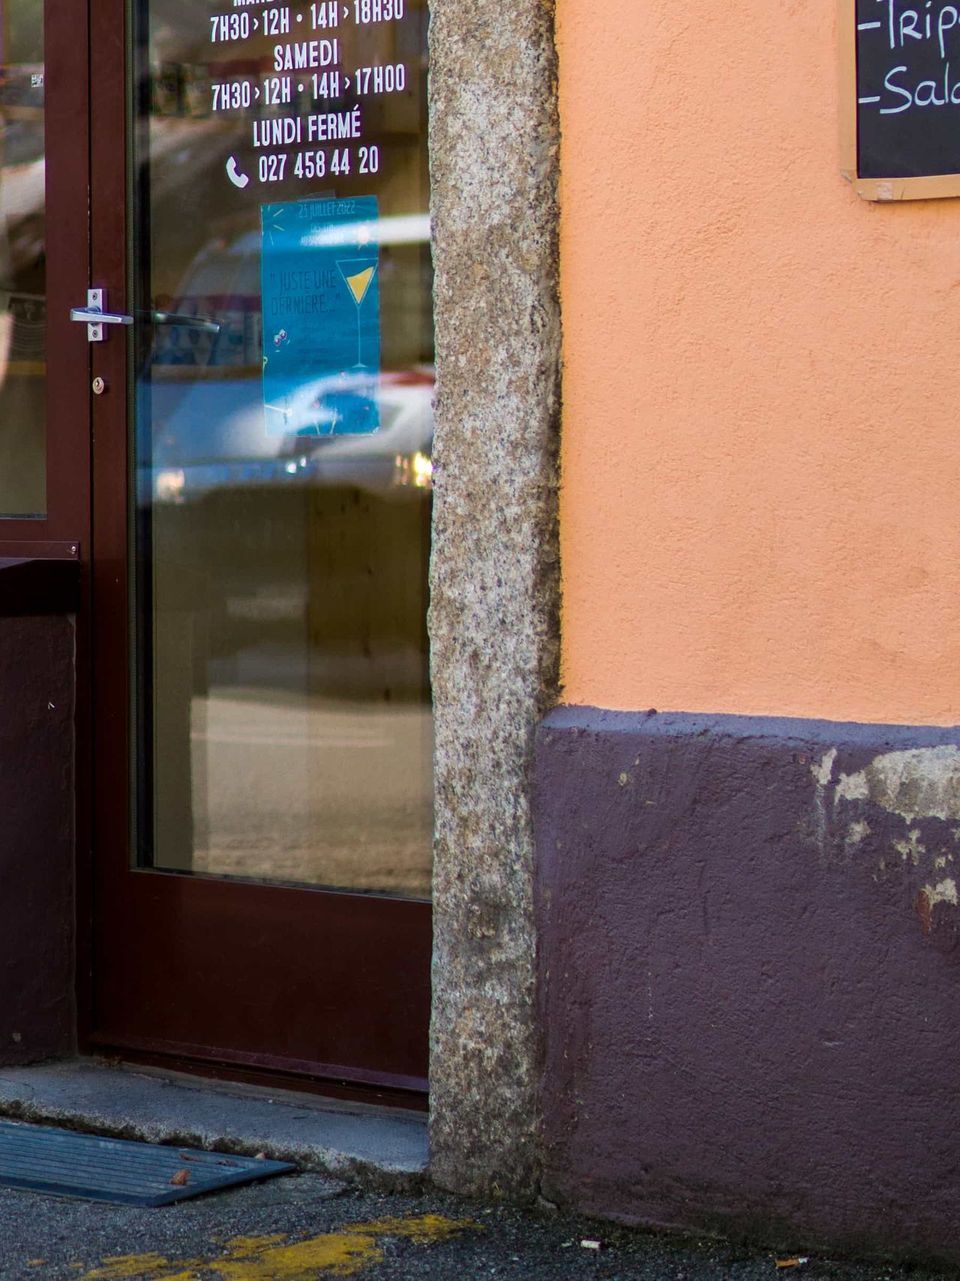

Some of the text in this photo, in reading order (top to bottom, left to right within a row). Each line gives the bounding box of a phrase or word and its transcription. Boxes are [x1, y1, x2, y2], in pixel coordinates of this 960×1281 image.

[273, 38, 338, 72] SAMEDI
[253, 104, 361, 147] LUNDI FERMÉ
[258, 145, 379, 183] 027 458 44 20
